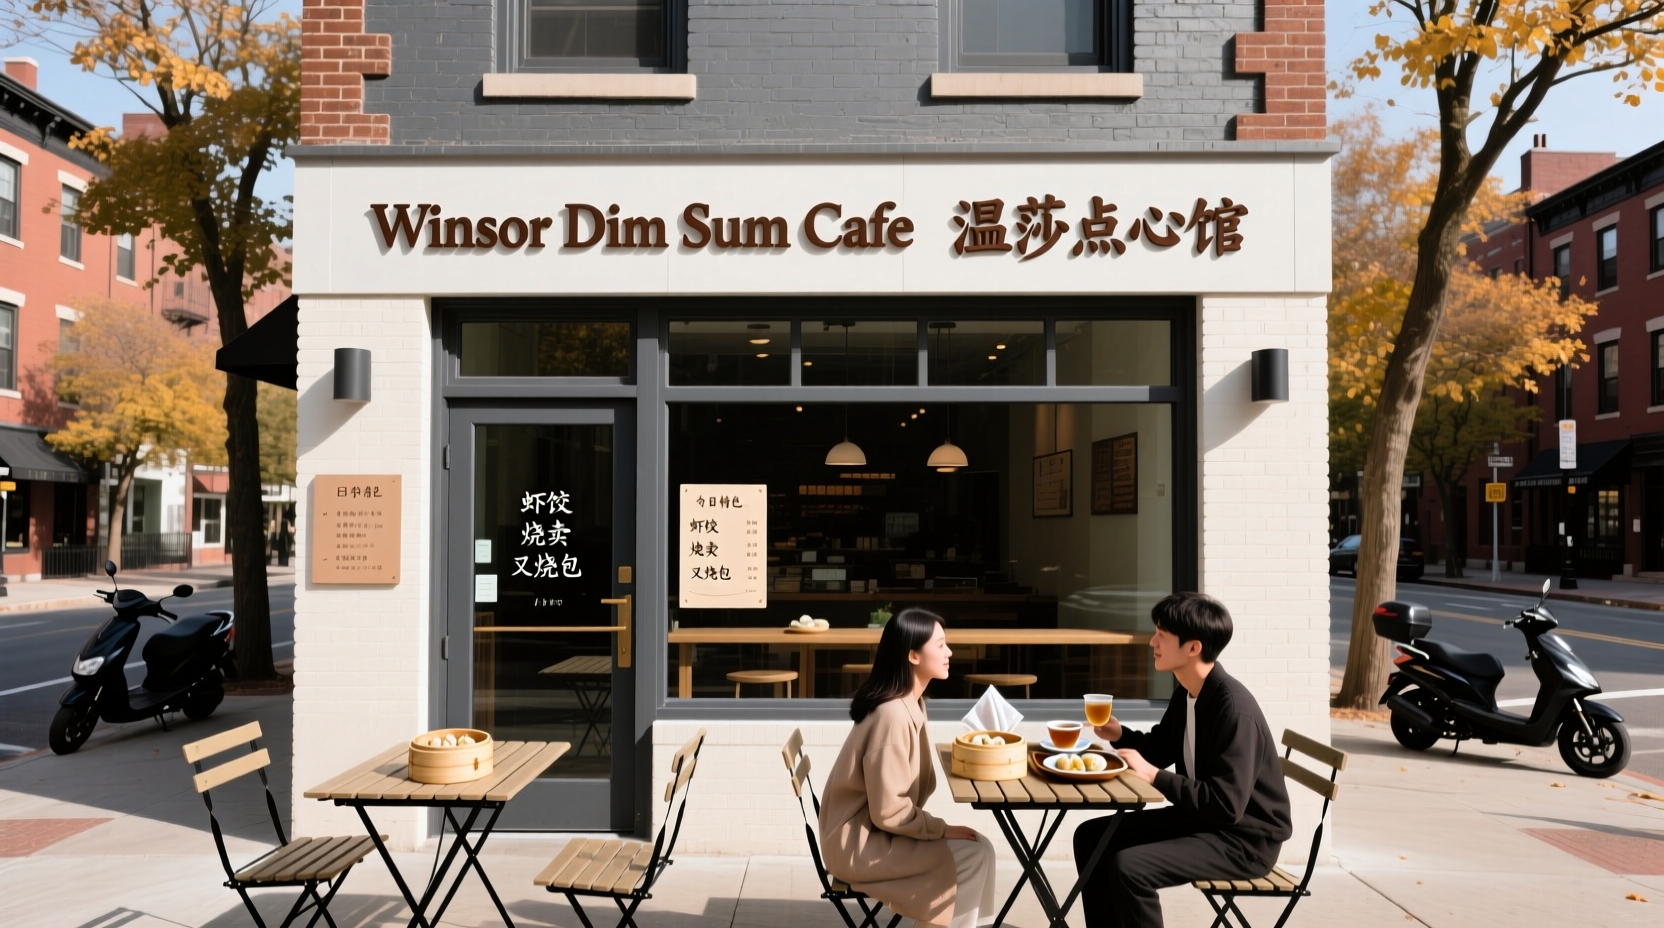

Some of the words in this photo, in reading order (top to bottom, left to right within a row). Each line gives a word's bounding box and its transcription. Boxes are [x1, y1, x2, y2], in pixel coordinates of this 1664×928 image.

[370, 203, 553, 248] Winsor
[563, 203, 669, 248] Dim
[683, 202, 791, 248] Sum
[804, 201, 914, 248] Cafe
[953, 194, 1249, 262] 温莎点心馆
[521, 490, 573, 514] 虾饺
[521, 519, 571, 546] 烧卖
